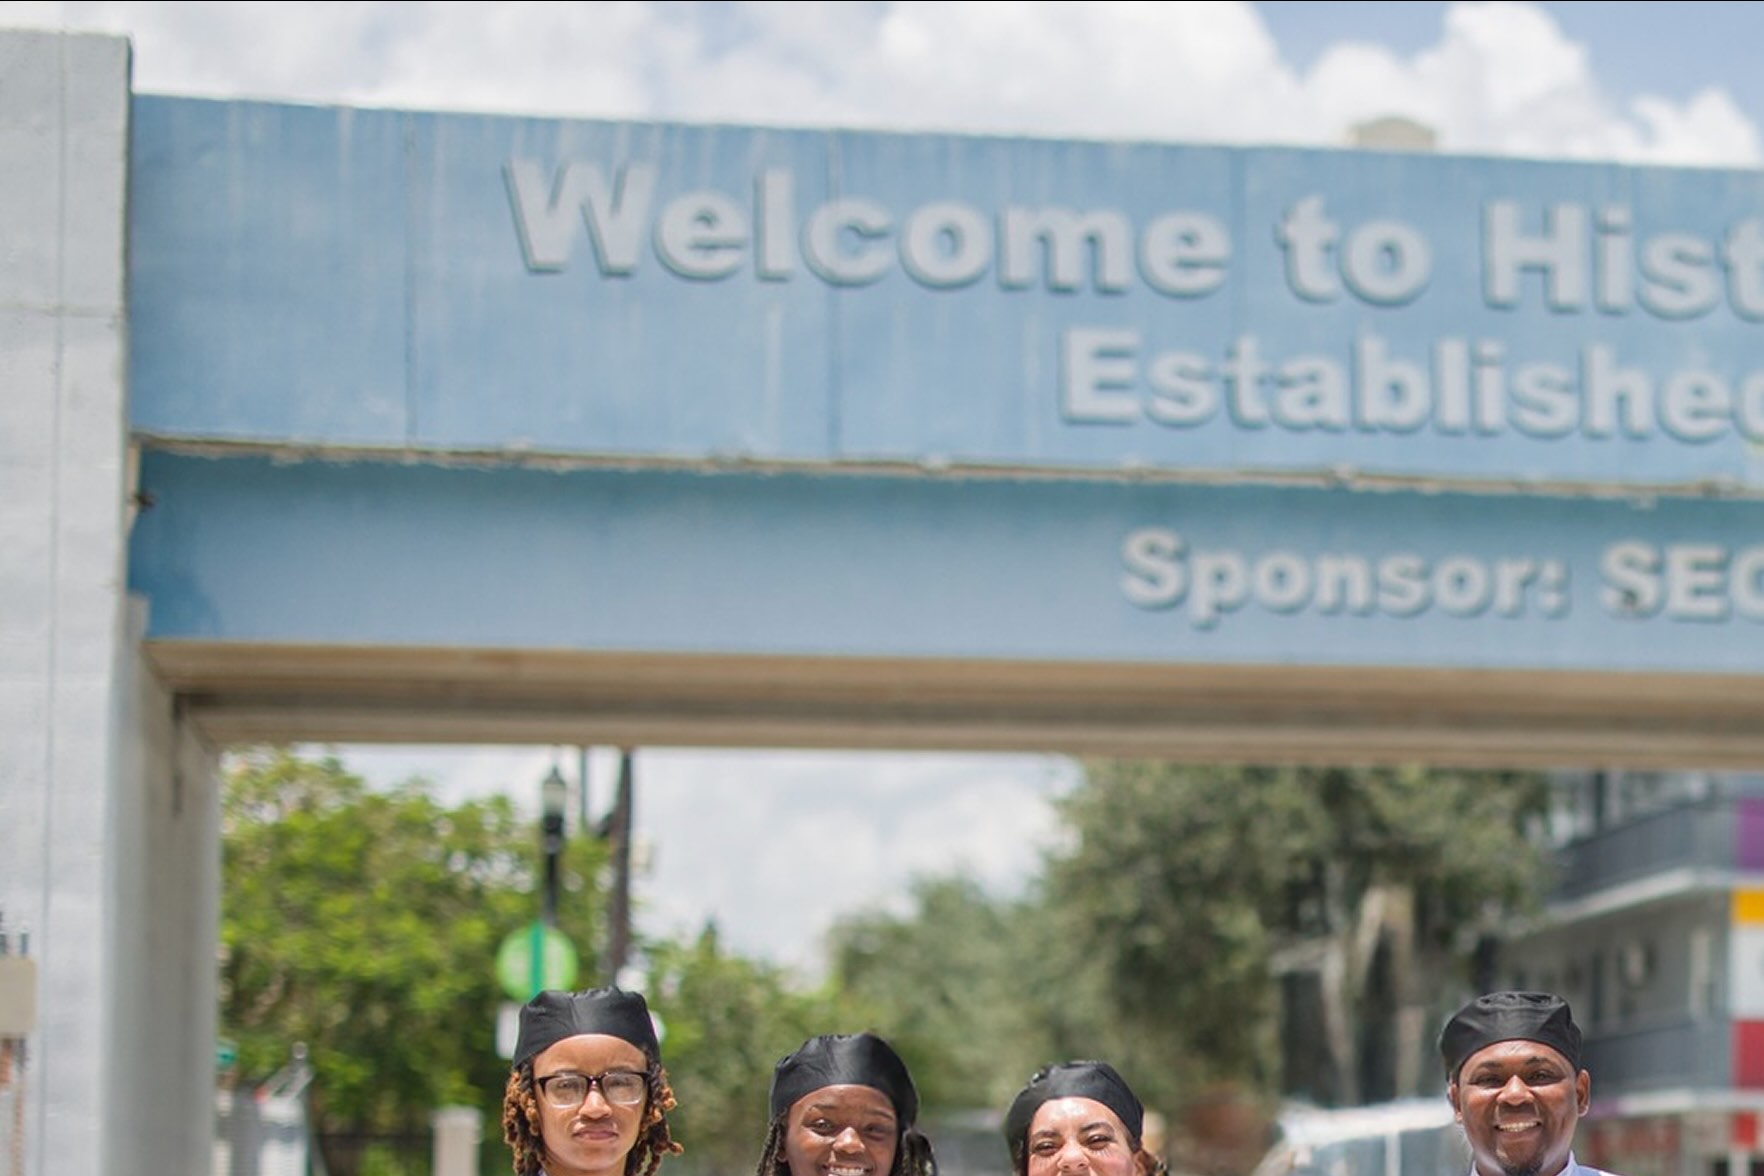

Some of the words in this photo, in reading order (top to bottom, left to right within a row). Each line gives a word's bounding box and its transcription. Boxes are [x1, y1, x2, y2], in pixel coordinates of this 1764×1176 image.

[502, 154, 1233, 298] Welcome
[1276, 194, 1432, 307] to
[1120, 526, 1571, 631] Sponsor:
